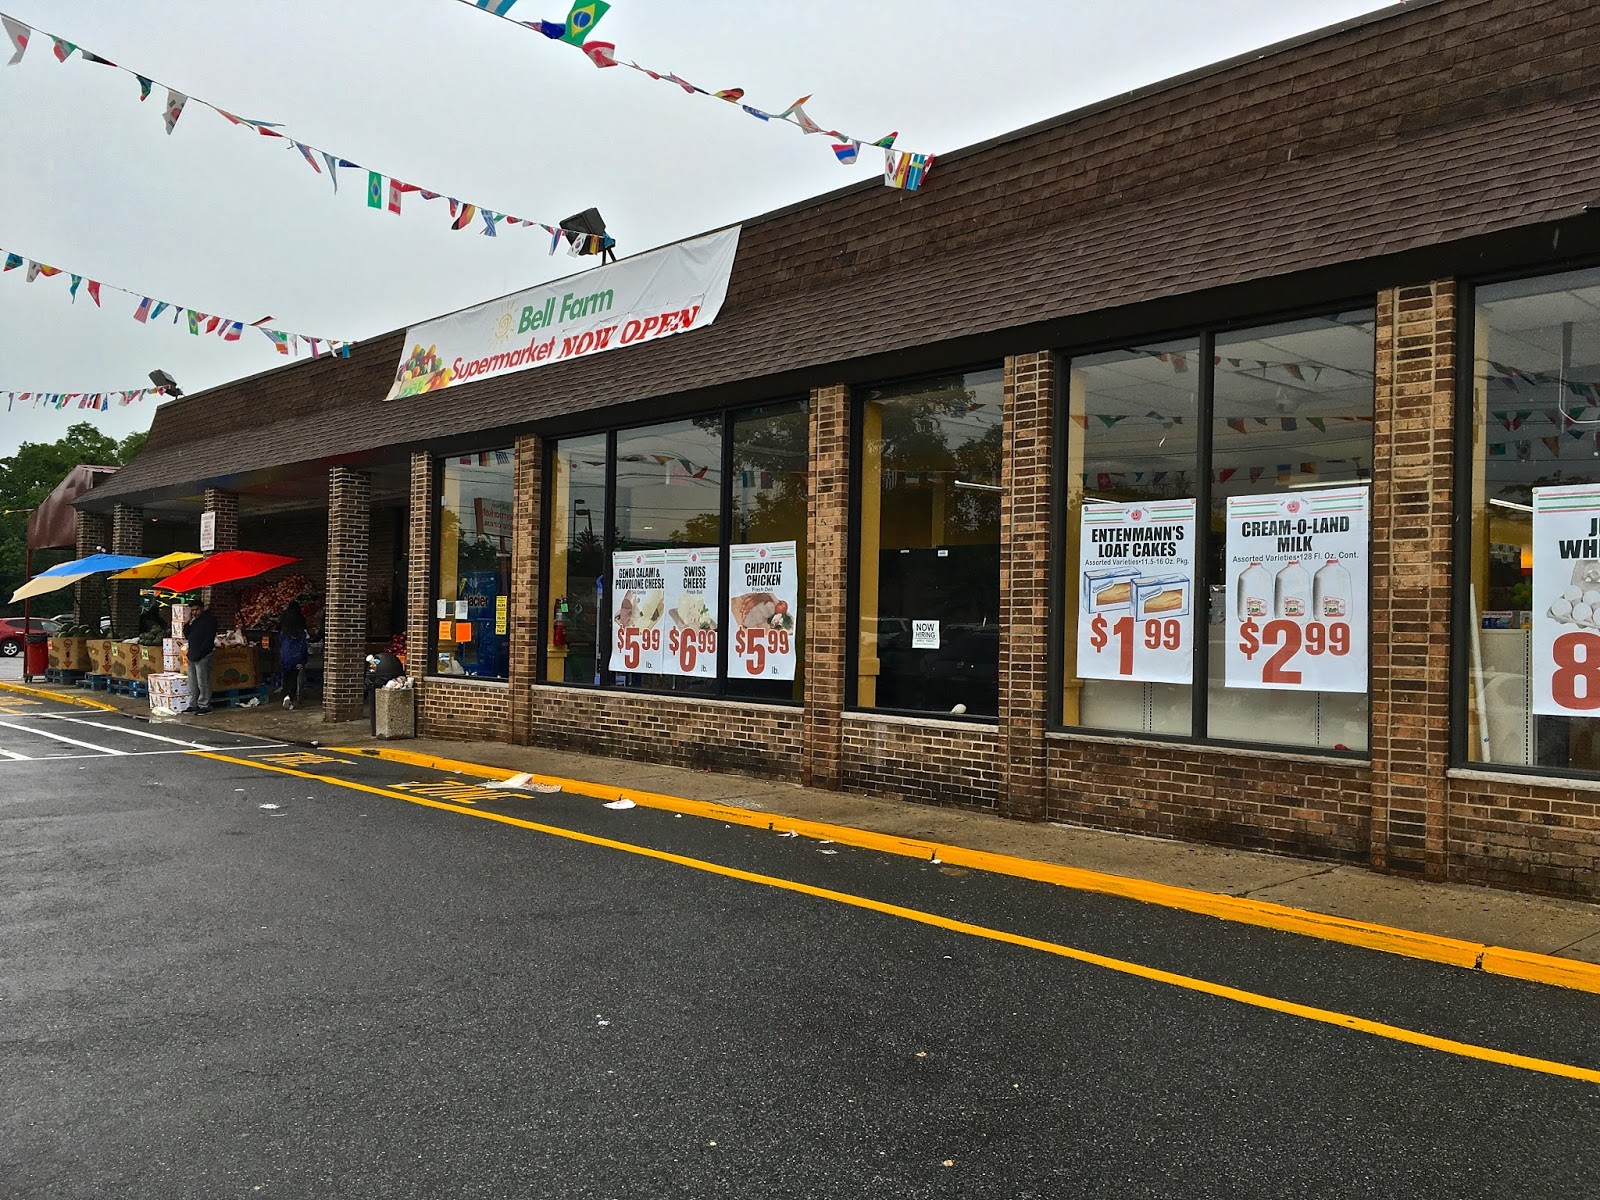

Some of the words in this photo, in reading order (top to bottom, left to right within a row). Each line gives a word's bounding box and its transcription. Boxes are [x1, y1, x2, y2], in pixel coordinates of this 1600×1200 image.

[517, 296, 556, 334] Bell
[558, 288, 614, 323] Farm
[449, 335, 556, 382] Supermarket
[555, 325, 618, 359] NOW
[620, 305, 700, 345] OPEN
[1241, 516, 1350, 537] CREAM-O-LAND
[1588, 517, 1600, 537] J
[1091, 525, 1184, 543] ENTENMANN'S
[1098, 543, 1129, 558] LOAF
[1132, 542, 1176, 557] CAKES
[1277, 536, 1313, 552] MILK
[1558, 539, 1600, 559] WH
[1084, 558, 1111, 566] Assorted
[1176, 557, 1190, 565] Pkg.
[1232, 554, 1263, 563] Assorted
[1324, 552, 1336, 560] Oz.
[1338, 551, 1359, 559] Cont.
[618, 568, 635, 578] GENOA
[636, 567, 655, 578] SALAMI
[656, 568, 660, 577] &
[684, 566, 706, 577] SWISS
[744, 561, 782, 574] CHIPOTLE
[615, 579, 644, 589] PROVOLONE
[645, 578, 665, 589] CHEESE
[683, 577, 706, 589] CHEESE
[746, 574, 781, 586] CHICKEN
[916, 623, 935, 631] NOW
[645, 660, 653, 669] lb.
[700, 663, 708, 673] lb.
[771, 666, 779, 675] lb.
